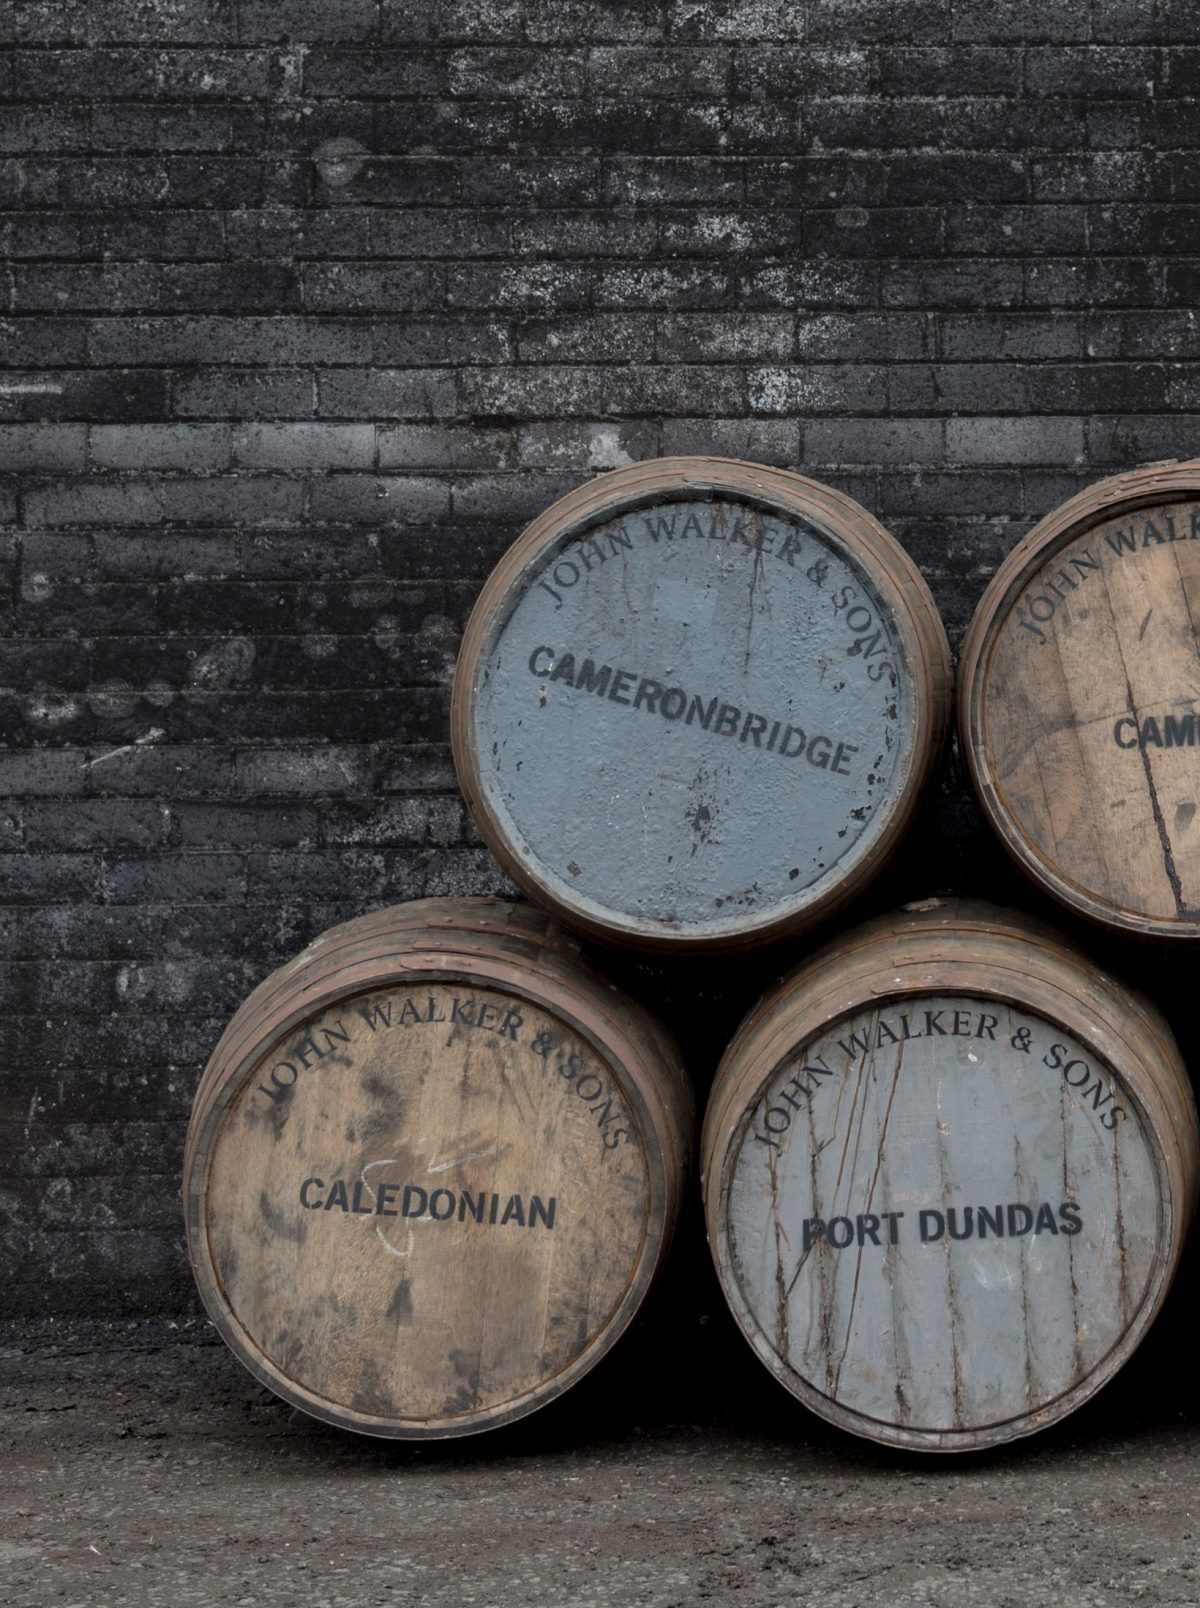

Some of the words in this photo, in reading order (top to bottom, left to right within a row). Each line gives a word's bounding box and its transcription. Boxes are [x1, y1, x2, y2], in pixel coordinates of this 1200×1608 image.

[538, 526, 633, 609] JOHN
[644, 515, 802, 566] WALKER
[806, 558, 828, 588] &
[831, 586, 897, 685] SONS
[1019, 549, 1100, 645] JOHN
[528, 645, 859, 776] CAMERONBRIDGE
[258, 1020, 351, 1111] JOHN
[358, 997, 524, 1041] WALKER
[531, 1032, 553, 1058] &
[558, 1054, 630, 1150] SONS
[754, 1056, 833, 1157] JOHN
[837, 1011, 999, 1061] WALKER
[1011, 1026, 1033, 1053] &
[1042, 1044, 1127, 1131] SONS
[300, 1178, 556, 1229] CALEDONIAN
[803, 1212, 904, 1251] PORT
[919, 1202, 1083, 1242] DUNDAS
